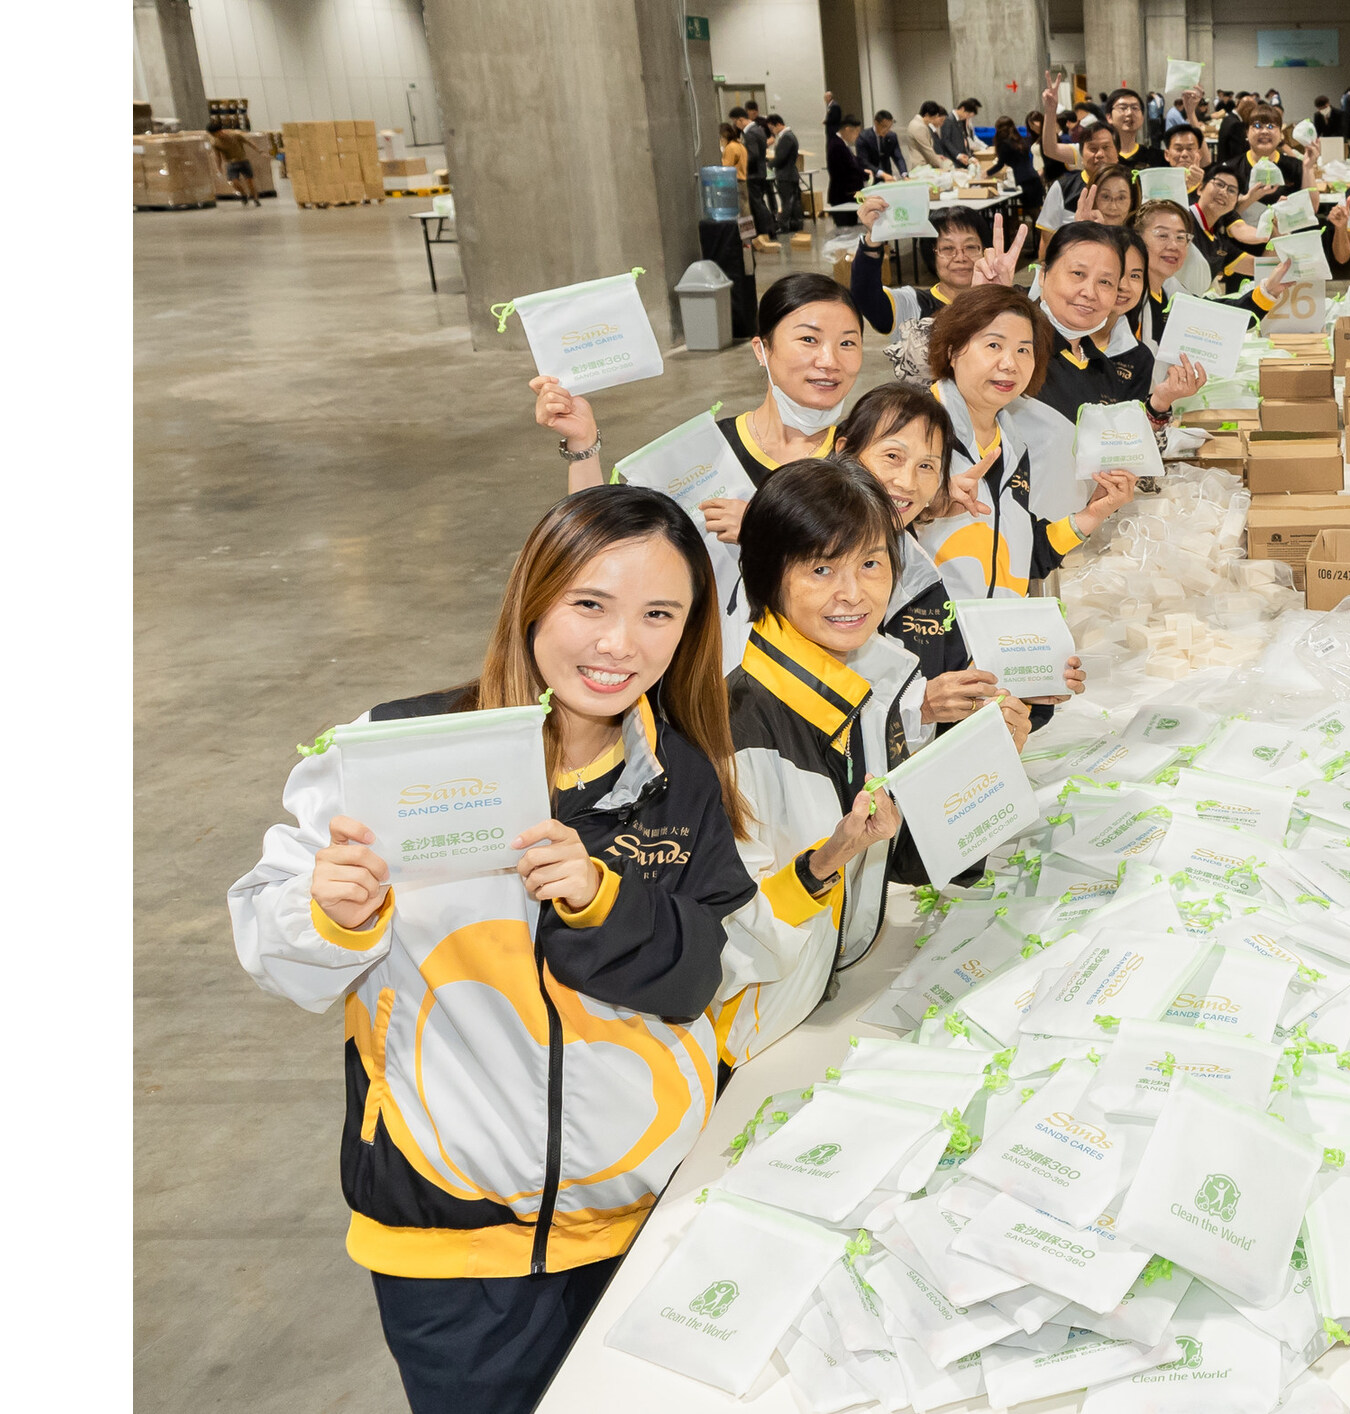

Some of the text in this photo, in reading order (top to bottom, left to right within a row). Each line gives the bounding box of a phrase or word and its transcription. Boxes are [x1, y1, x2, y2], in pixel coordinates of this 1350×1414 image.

[1267, 282, 1317, 320] 26
[561, 323, 619, 346] Sands
[668, 463, 713, 495] Sands
[998, 633, 1047, 646] Sands
[1000, 645, 1026, 653] SANDS
[397, 777, 500, 805] Sands
[944, 771, 999, 816] Sands
[947, 781, 1005, 825] SANDS CARES
[398, 797, 502, 818] SANDS CARES
[957, 803, 1015, 849] 金沙環保360
[401, 827, 504, 852] 金沙環保360
[603, 834, 691, 866] Sands
[1123, 829, 1167, 857] Sands
[402, 850, 447, 862] SANDS
[1193, 848, 1246, 867] Sand
[1069, 880, 1119, 895] Sand
[1098, 953, 1144, 1006] Sands
[1171, 993, 1243, 1014] Sands
[1165, 1009, 1238, 1024] SANDS CARES
[1035, 1122, 1104, 1161] SANDS CARES
[1045, 1111, 1113, 1150] Sands
[768, 1159, 793, 1173] Clean
[793, 1165, 807, 1175] the
[1001, 1152, 1031, 1170] SANDS
[1009, 1143, 1081, 1180] 金沙環保360
[1170, 1203, 1200, 1226] Clean
[1201, 1219, 1219, 1235] the
[1004, 1232, 1040, 1249] SANDS
[1011, 1223, 1096, 1260] 金沙環保360
[1084, 1225, 1117, 1241] ARES
[906, 1270, 929, 1293] SANDS
[660, 1306, 687, 1325] Clean
[685, 1316, 703, 1331] the
[1131, 1374, 1165, 1384] Clean
[1169, 1372, 1189, 1381] the
